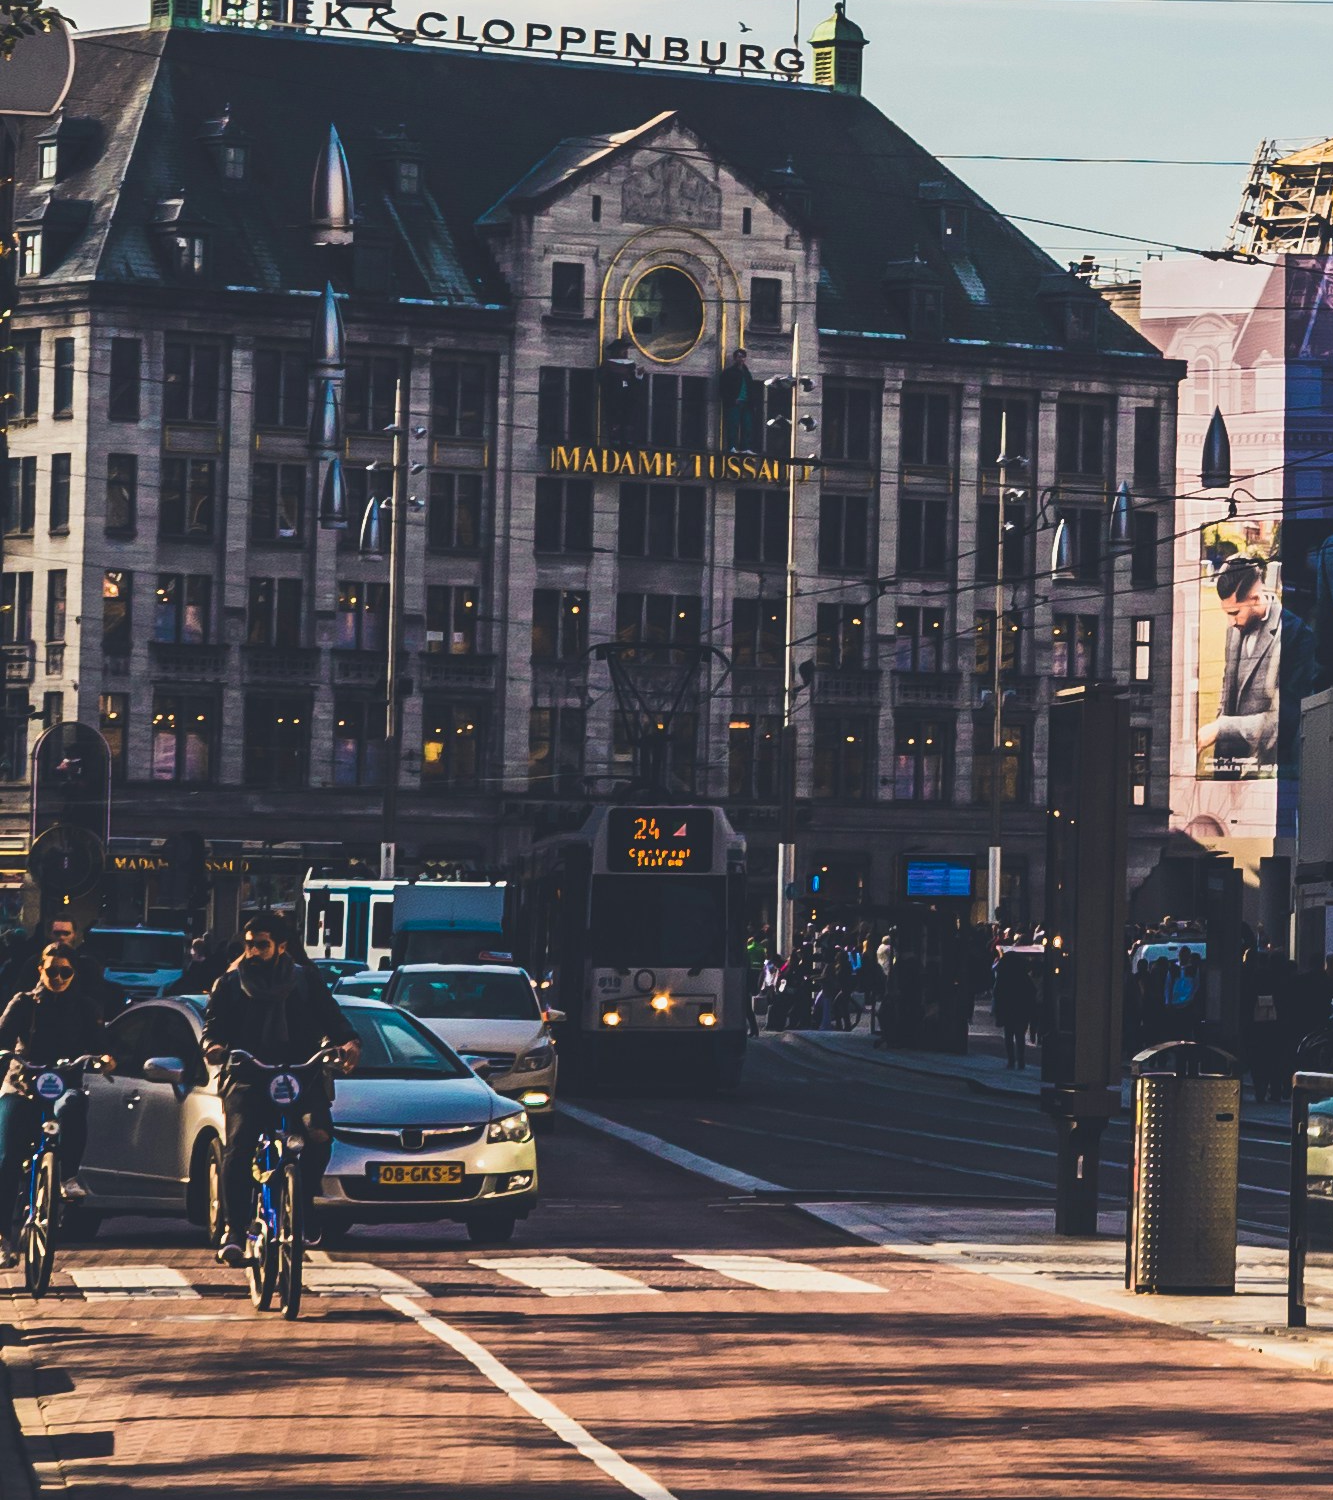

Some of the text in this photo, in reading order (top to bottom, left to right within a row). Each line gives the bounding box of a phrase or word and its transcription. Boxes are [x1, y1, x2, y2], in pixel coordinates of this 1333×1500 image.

[415, 11, 805, 73] CLOPPENBURG
[551, 445, 682, 478] MADAME
[633, 817, 660, 840] 24
